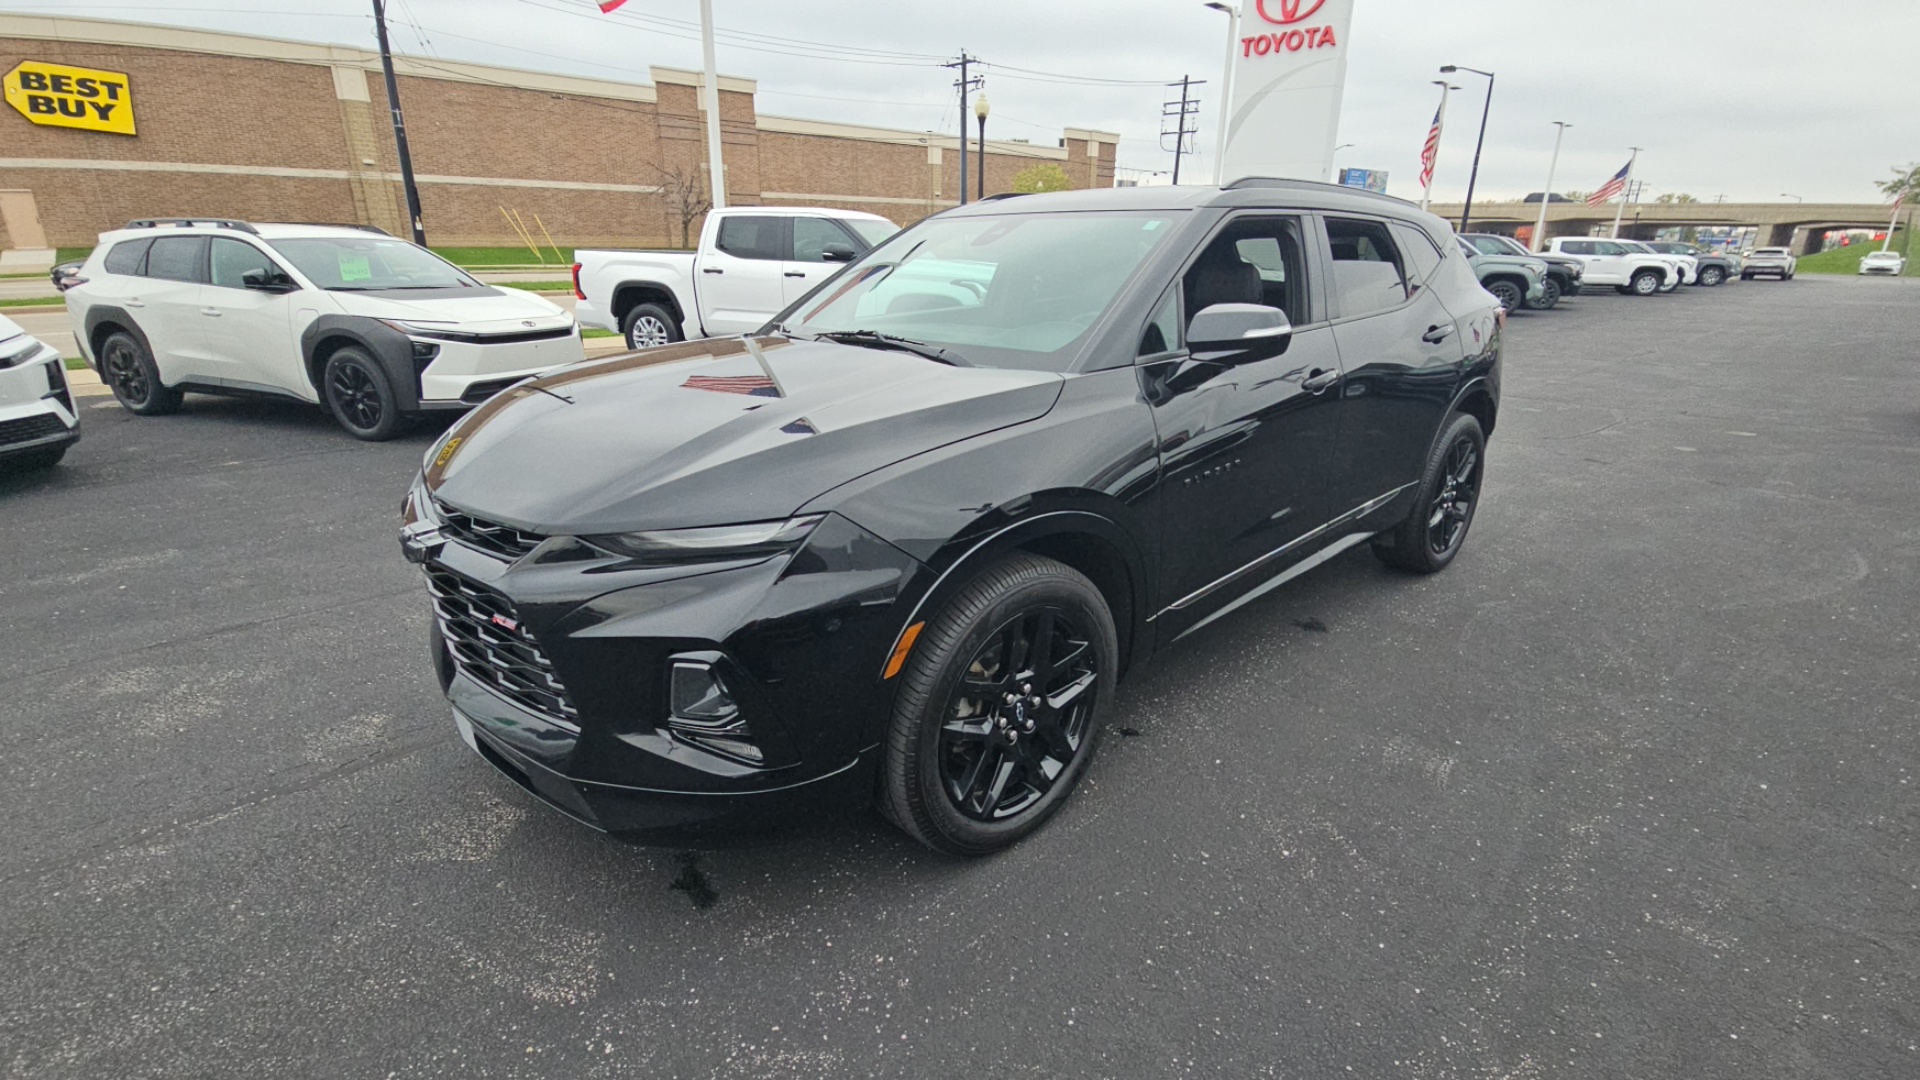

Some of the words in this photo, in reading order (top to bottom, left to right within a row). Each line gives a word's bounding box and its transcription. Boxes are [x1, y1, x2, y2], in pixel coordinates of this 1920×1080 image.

[1241, 25, 1336, 57] TOYOTA
[18, 70, 123, 101] BEST
[27, 94, 117, 121] BUY
